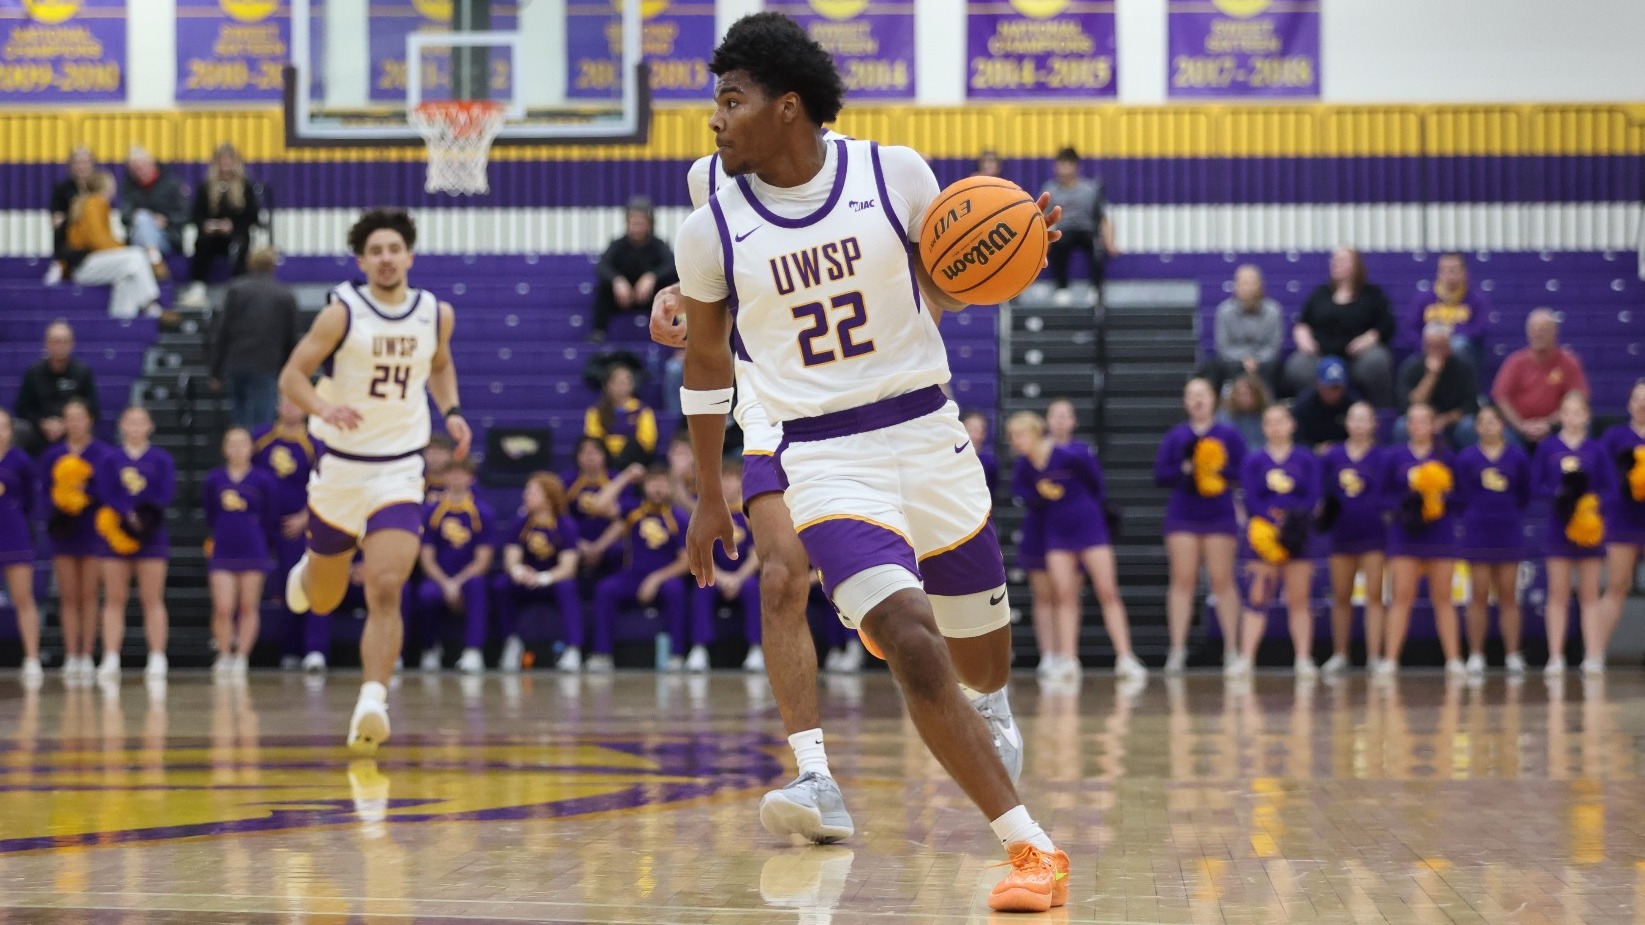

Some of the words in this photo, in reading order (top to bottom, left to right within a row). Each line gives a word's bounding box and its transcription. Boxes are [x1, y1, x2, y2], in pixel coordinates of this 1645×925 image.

[188, 60, 284, 89] 2010-20
[972, 57, 1111, 89] 2014-2015
[1175, 57, 1312, 87] 2017-2018
[933, 199, 971, 239] EVO
[769, 236, 861, 296] UWSP
[941, 222, 1017, 280] Wilson
[790, 289, 876, 368] 22
[368, 363, 410, 399] 24
